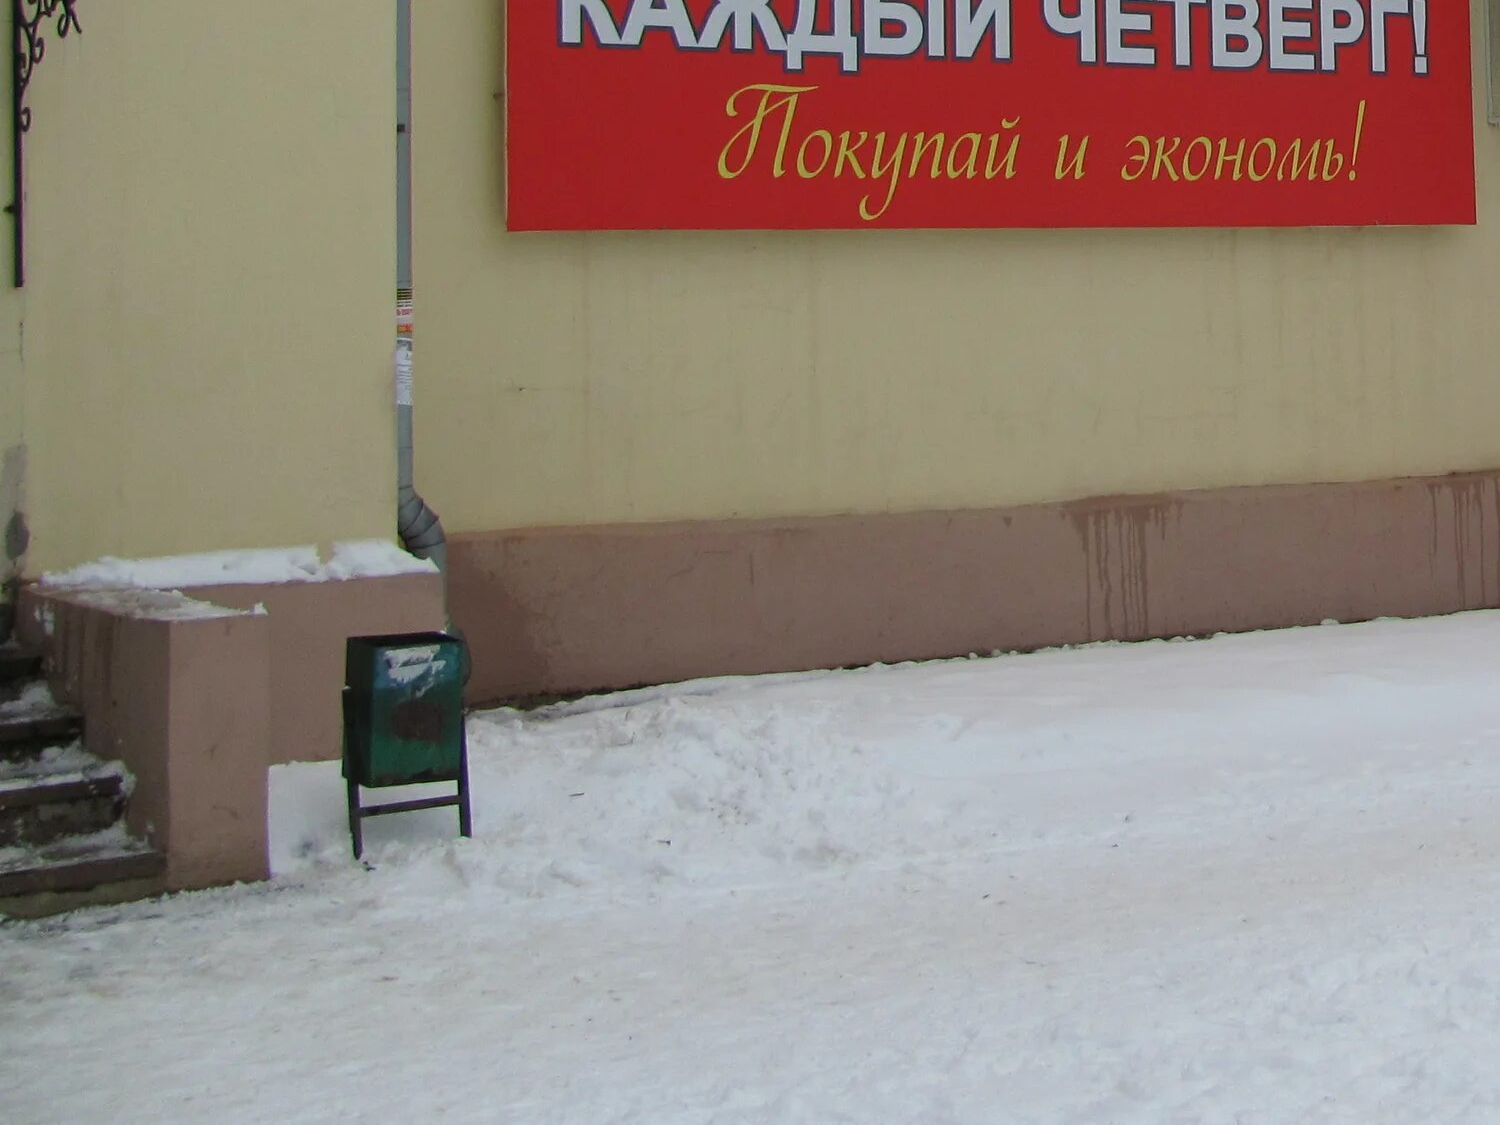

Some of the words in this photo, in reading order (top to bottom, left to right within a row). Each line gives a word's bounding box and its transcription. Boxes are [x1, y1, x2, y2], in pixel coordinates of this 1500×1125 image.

[717, 83, 1020, 221] Покупай
[1054, 134, 1089, 180] и
[1121, 99, 1366, 182] экономь!
